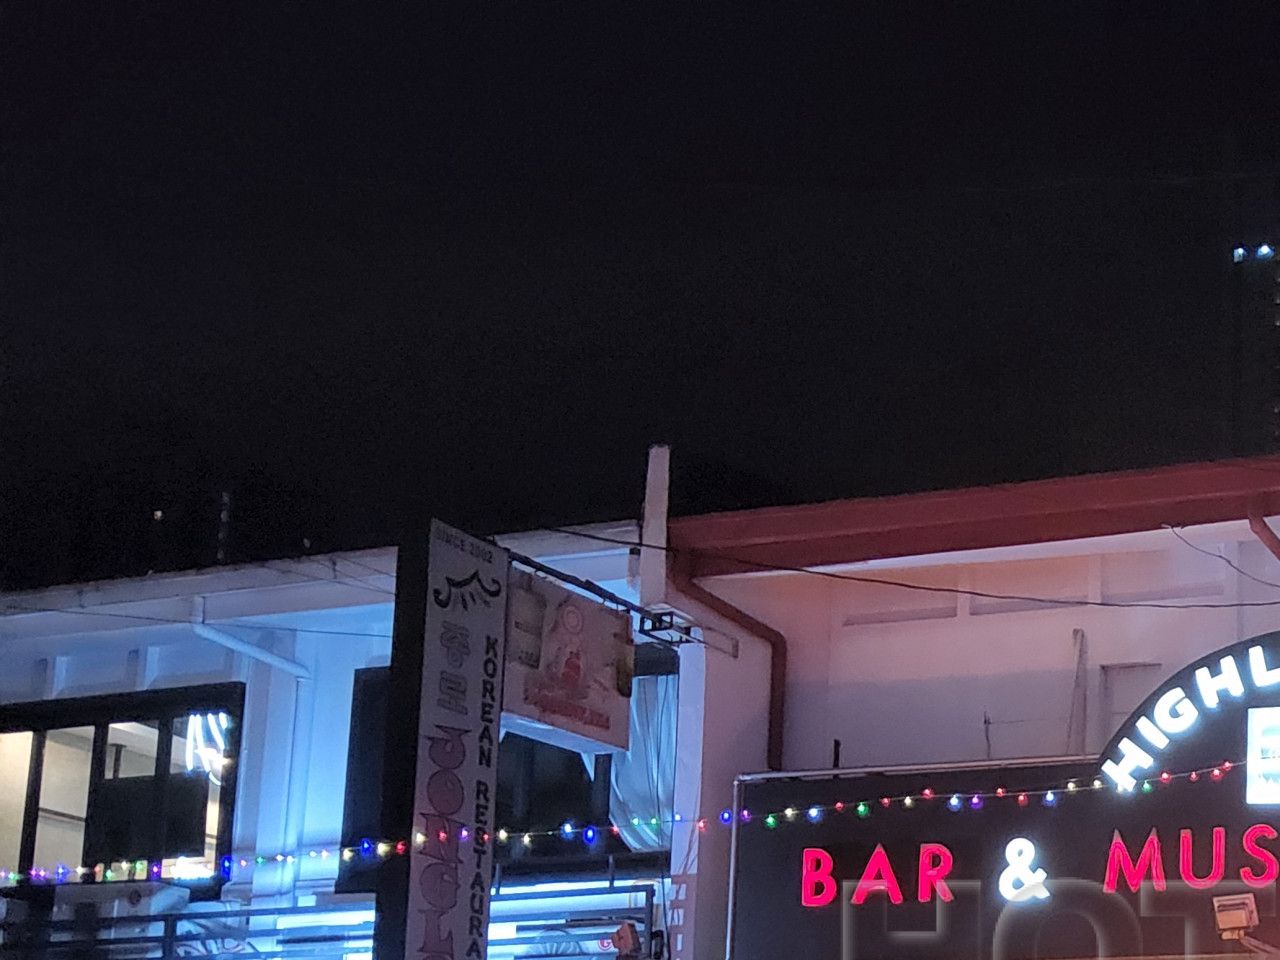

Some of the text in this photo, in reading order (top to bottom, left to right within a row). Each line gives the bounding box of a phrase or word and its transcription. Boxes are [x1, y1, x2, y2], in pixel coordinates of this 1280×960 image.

[477, 635, 499, 768] KOREAN
[801, 843, 954, 907] BAR
[998, 836, 1050, 902] &
